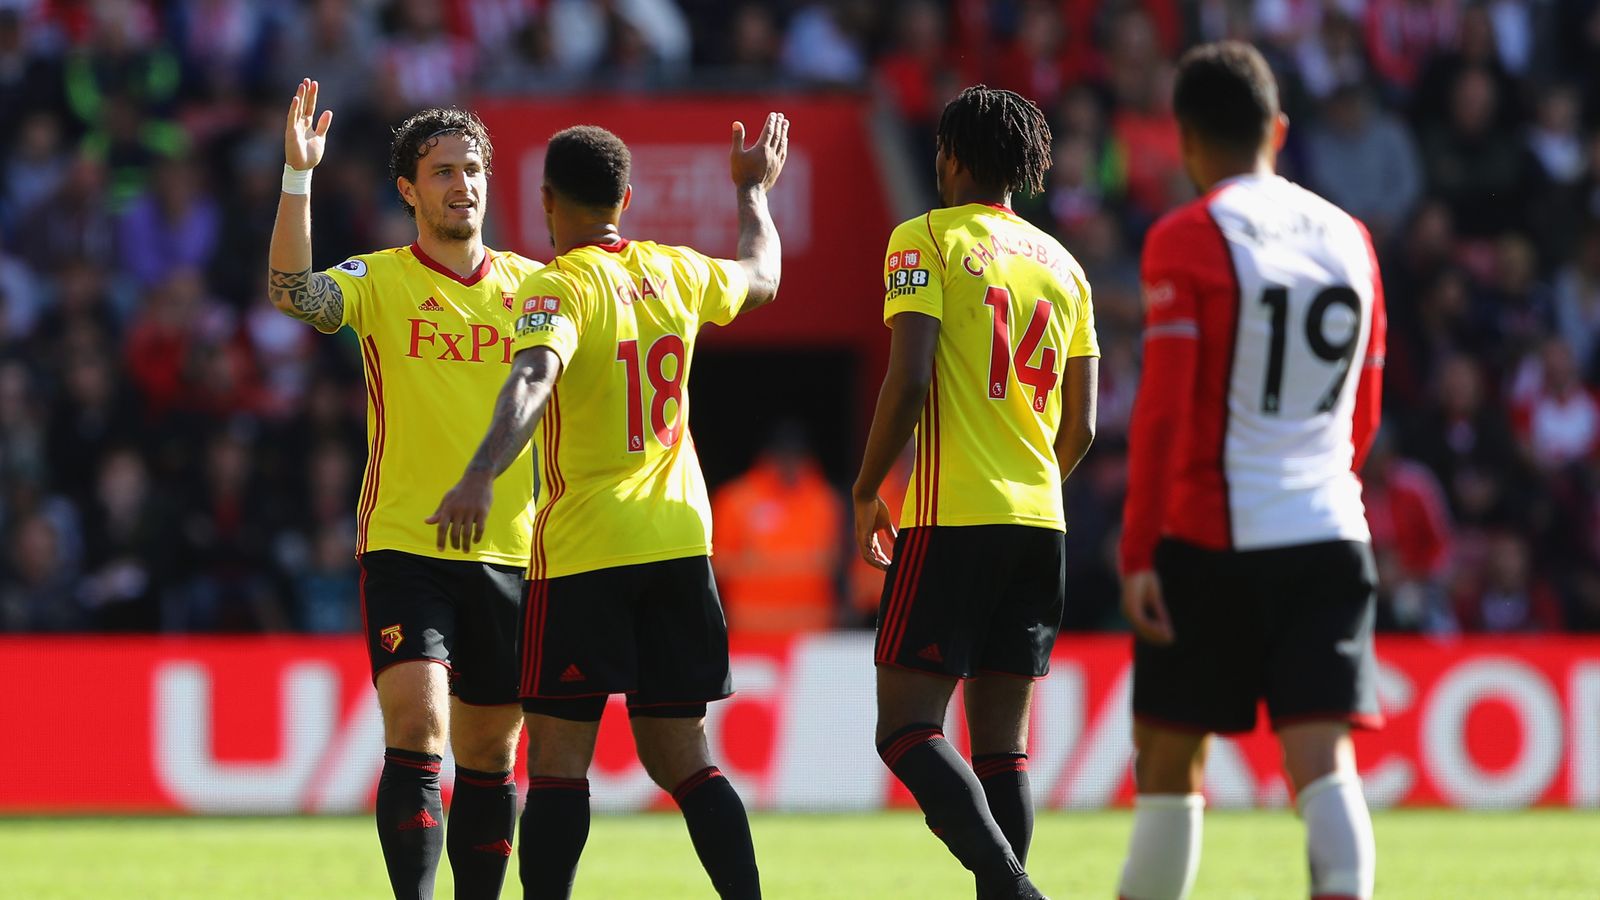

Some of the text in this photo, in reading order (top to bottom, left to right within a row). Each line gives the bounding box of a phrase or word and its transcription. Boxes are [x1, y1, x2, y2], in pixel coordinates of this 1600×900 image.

[615, 333, 686, 453] 18
[983, 285, 1059, 414] 14
[1259, 285, 1362, 415] 19
